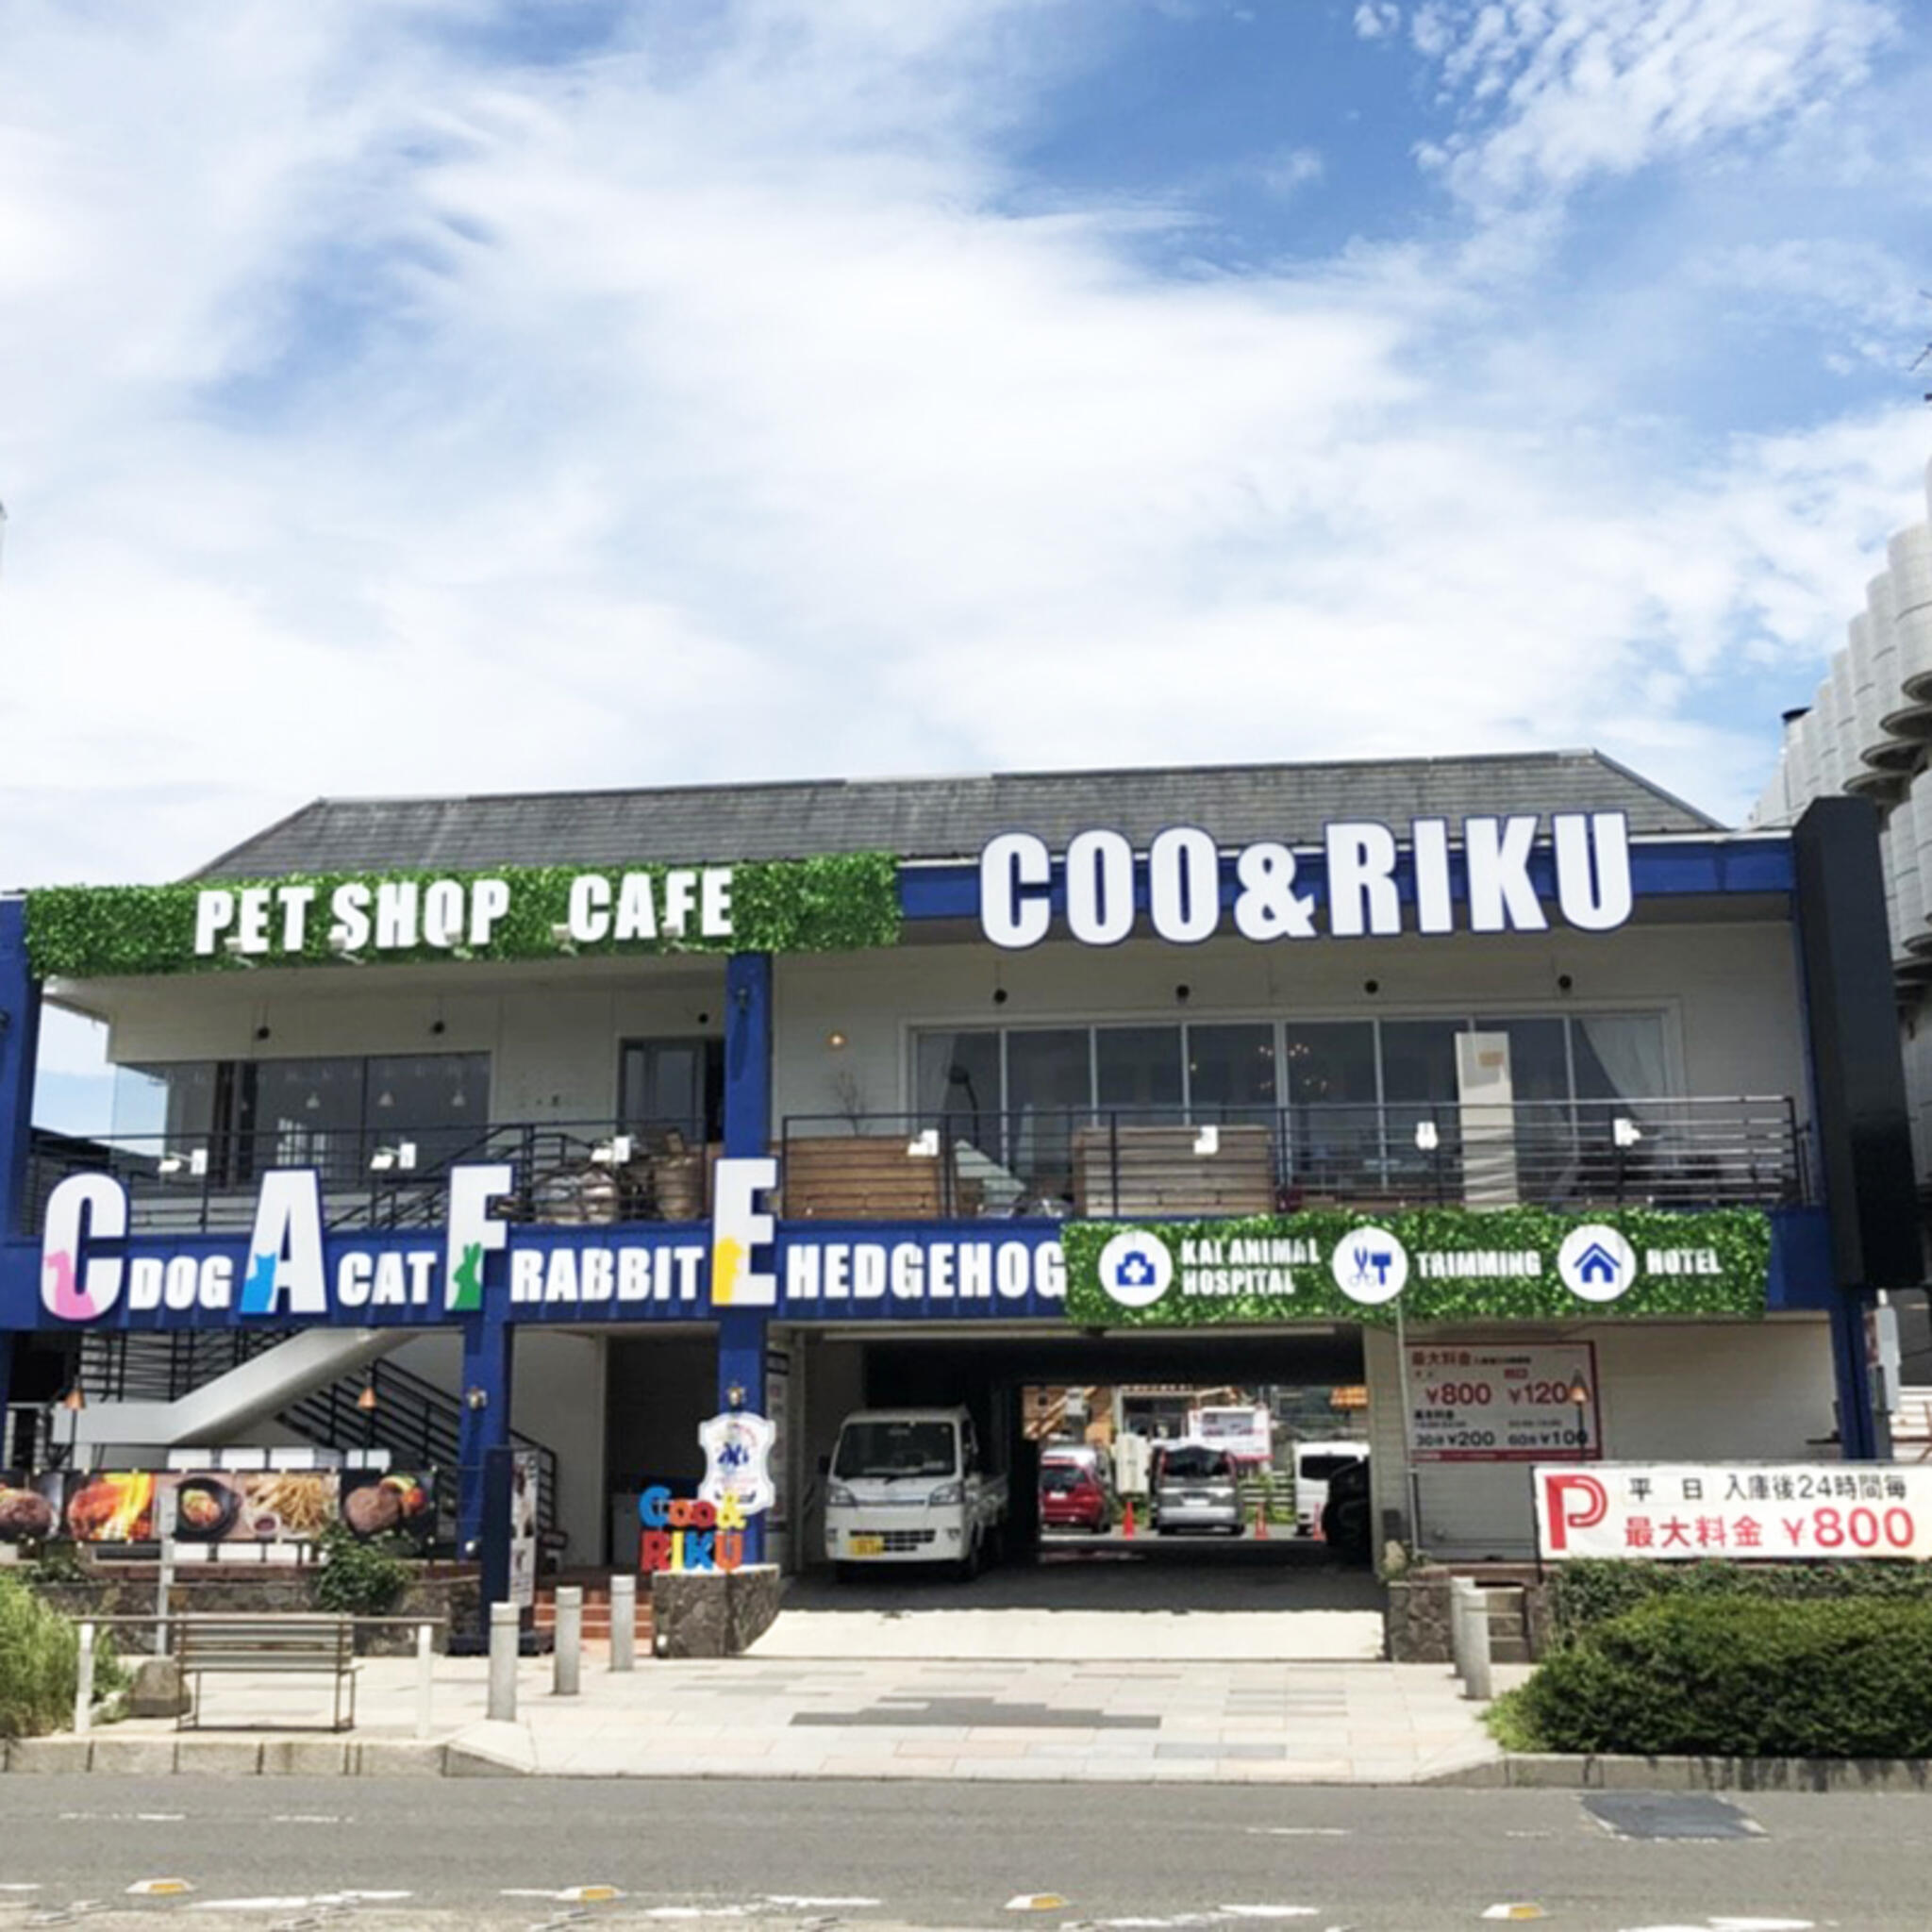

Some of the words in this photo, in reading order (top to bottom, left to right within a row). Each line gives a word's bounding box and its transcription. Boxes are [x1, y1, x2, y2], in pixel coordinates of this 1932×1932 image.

[981, 812, 1633, 948] COO&RIKU
[194, 888, 315, 955] PET
[331, 879, 509, 951] SHOP
[569, 869, 733, 942] CAFE
[1228, 1238, 1320, 1264] ANIMAL
[1416, 1250, 1541, 1277] TRIMMING
[1646, 1248, 1722, 1274] HOTEL
[128, 1256, 233, 1309] DOG
[338, 1252, 437, 1306] CAT
[510, 1246, 704, 1302] RABBIT
[787, 1241, 1067, 1298] HEDGEHOG
[1182, 1269, 1295, 1295] HOSPITAL
[1508, 1382, 1589, 1405] ¥120
[1544, 1474, 1607, 1550] P
[1624, 1515, 1762, 1549] 最大料金
[1782, 1507, 1914, 1549] ¥800
[641, 1530, 742, 1573] RIKU
